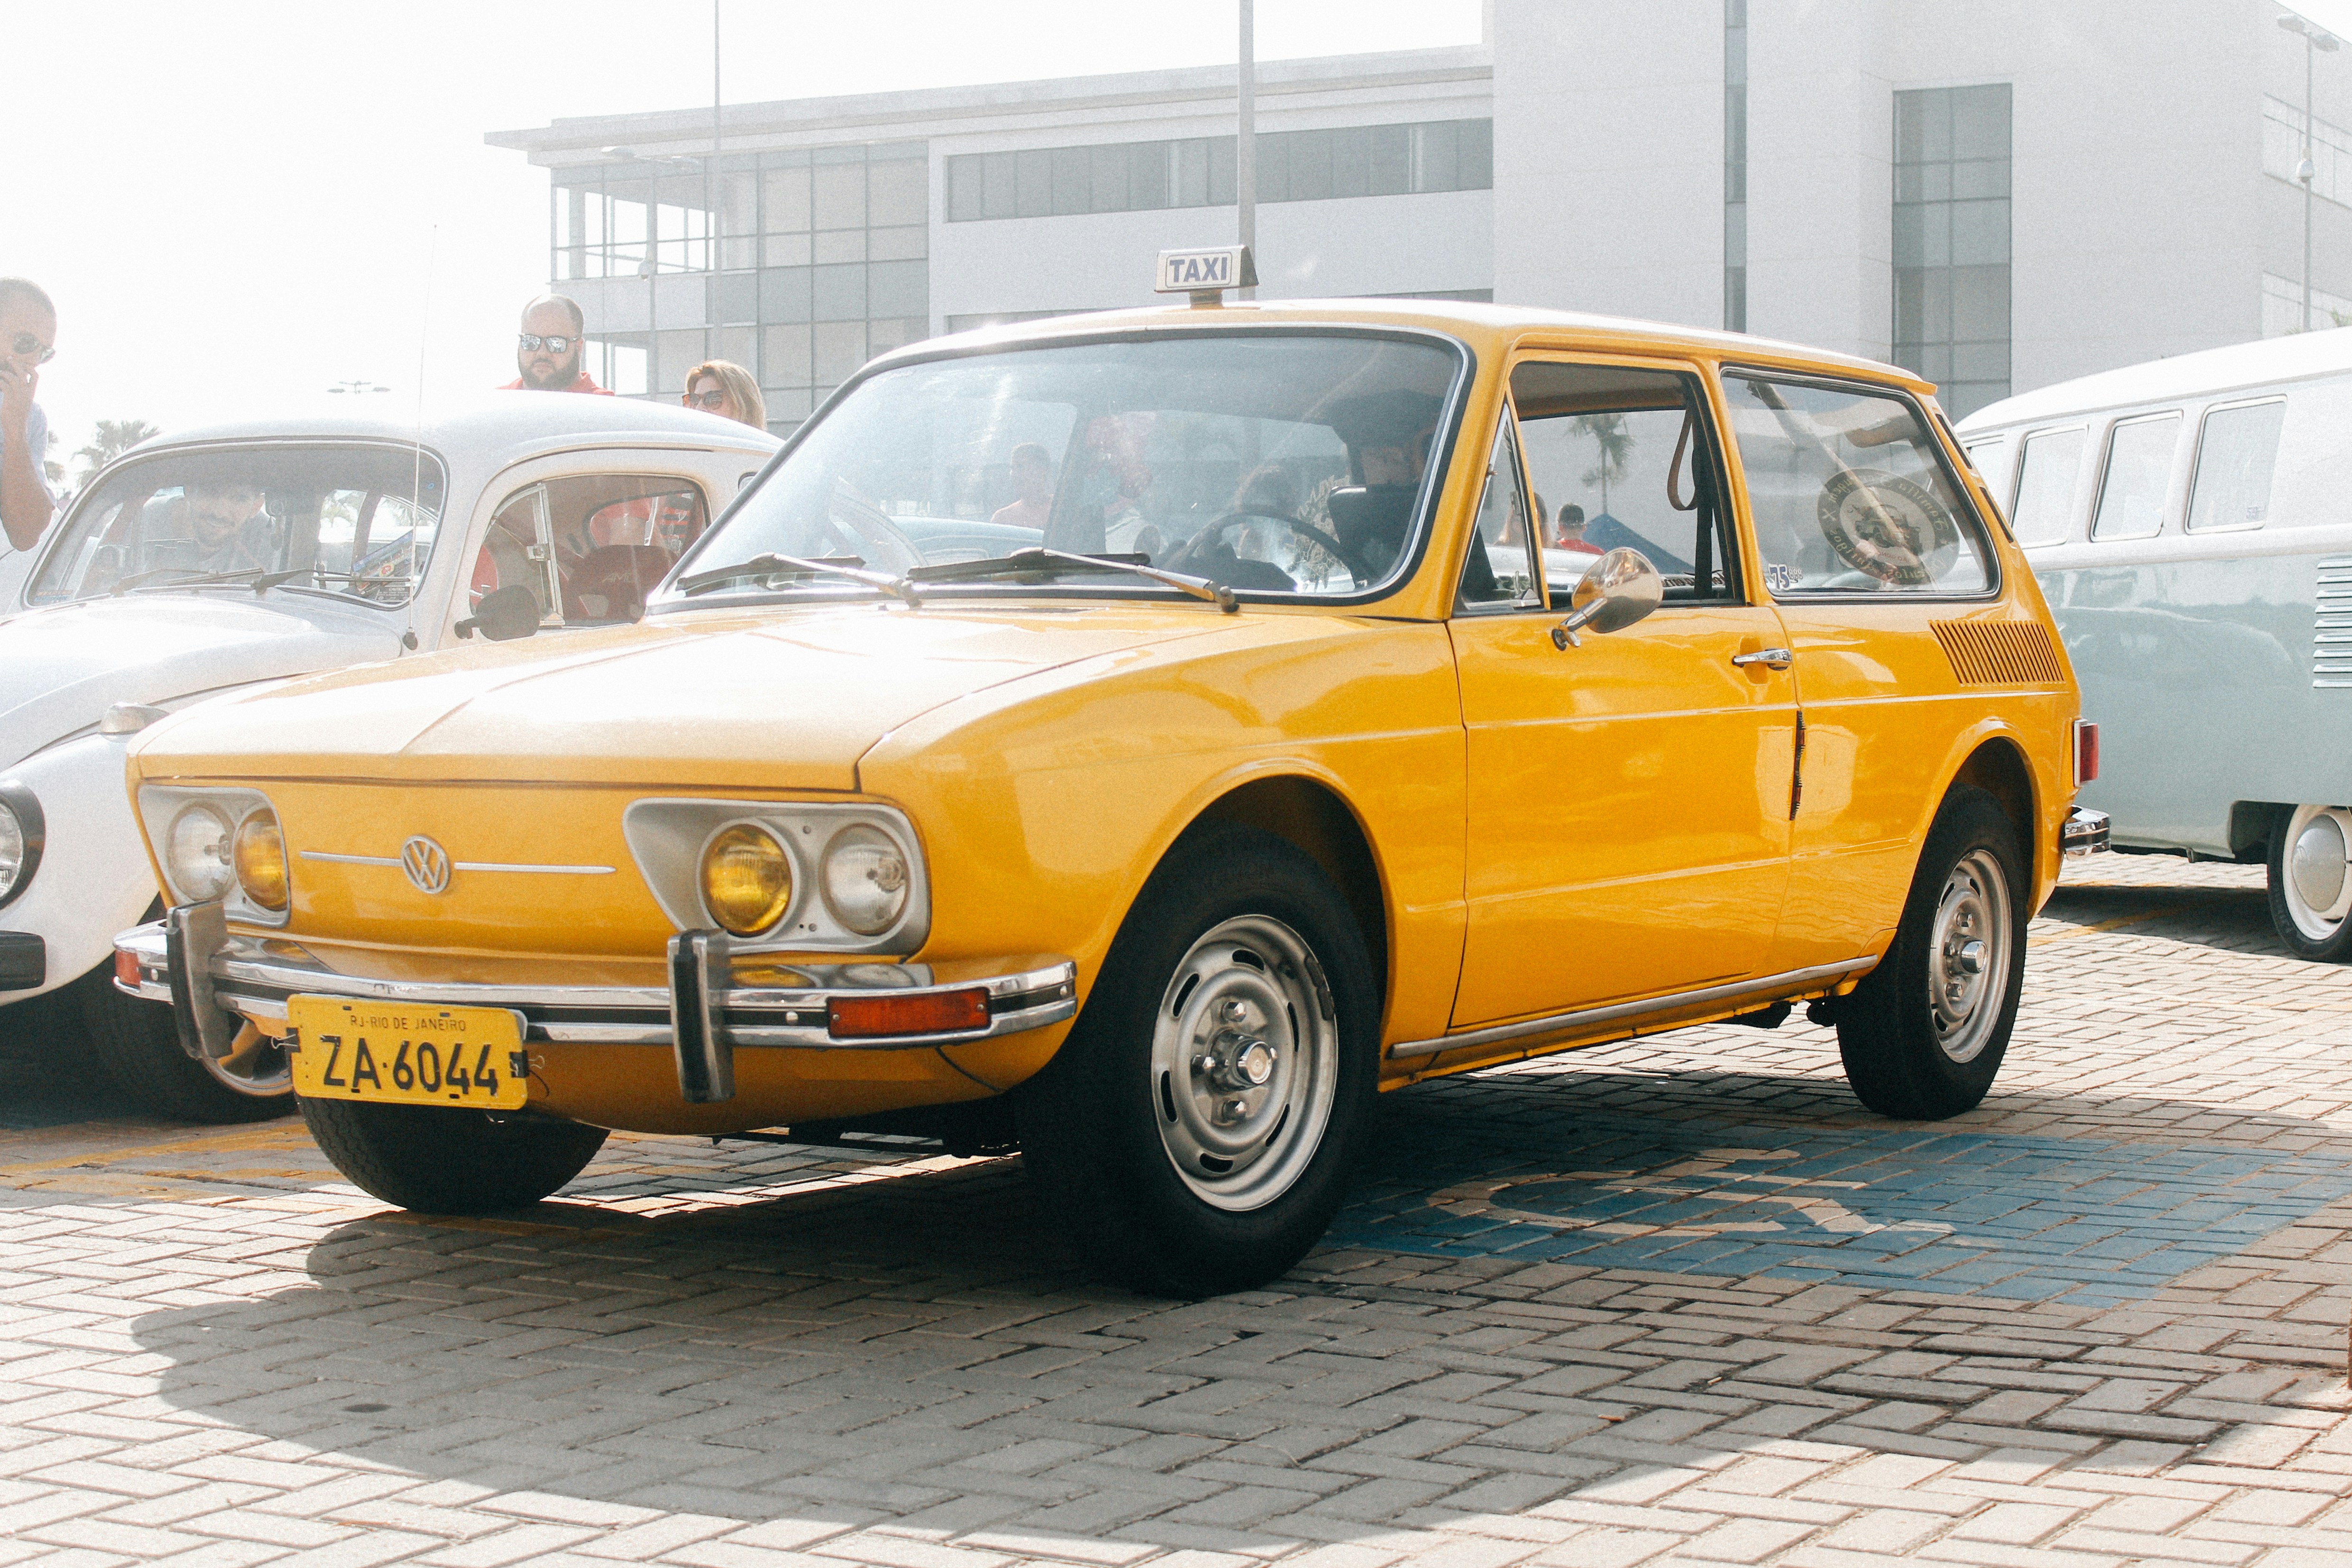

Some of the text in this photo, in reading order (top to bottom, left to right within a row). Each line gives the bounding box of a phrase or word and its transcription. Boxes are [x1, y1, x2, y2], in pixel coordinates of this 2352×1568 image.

[1769, 564, 1790, 590] 75
[402, 836, 449, 894] VW
[350, 1015, 467, 1032] RJ-RIO DE JANEIRO
[1169, 1206, 1227, 1231] TAXI
